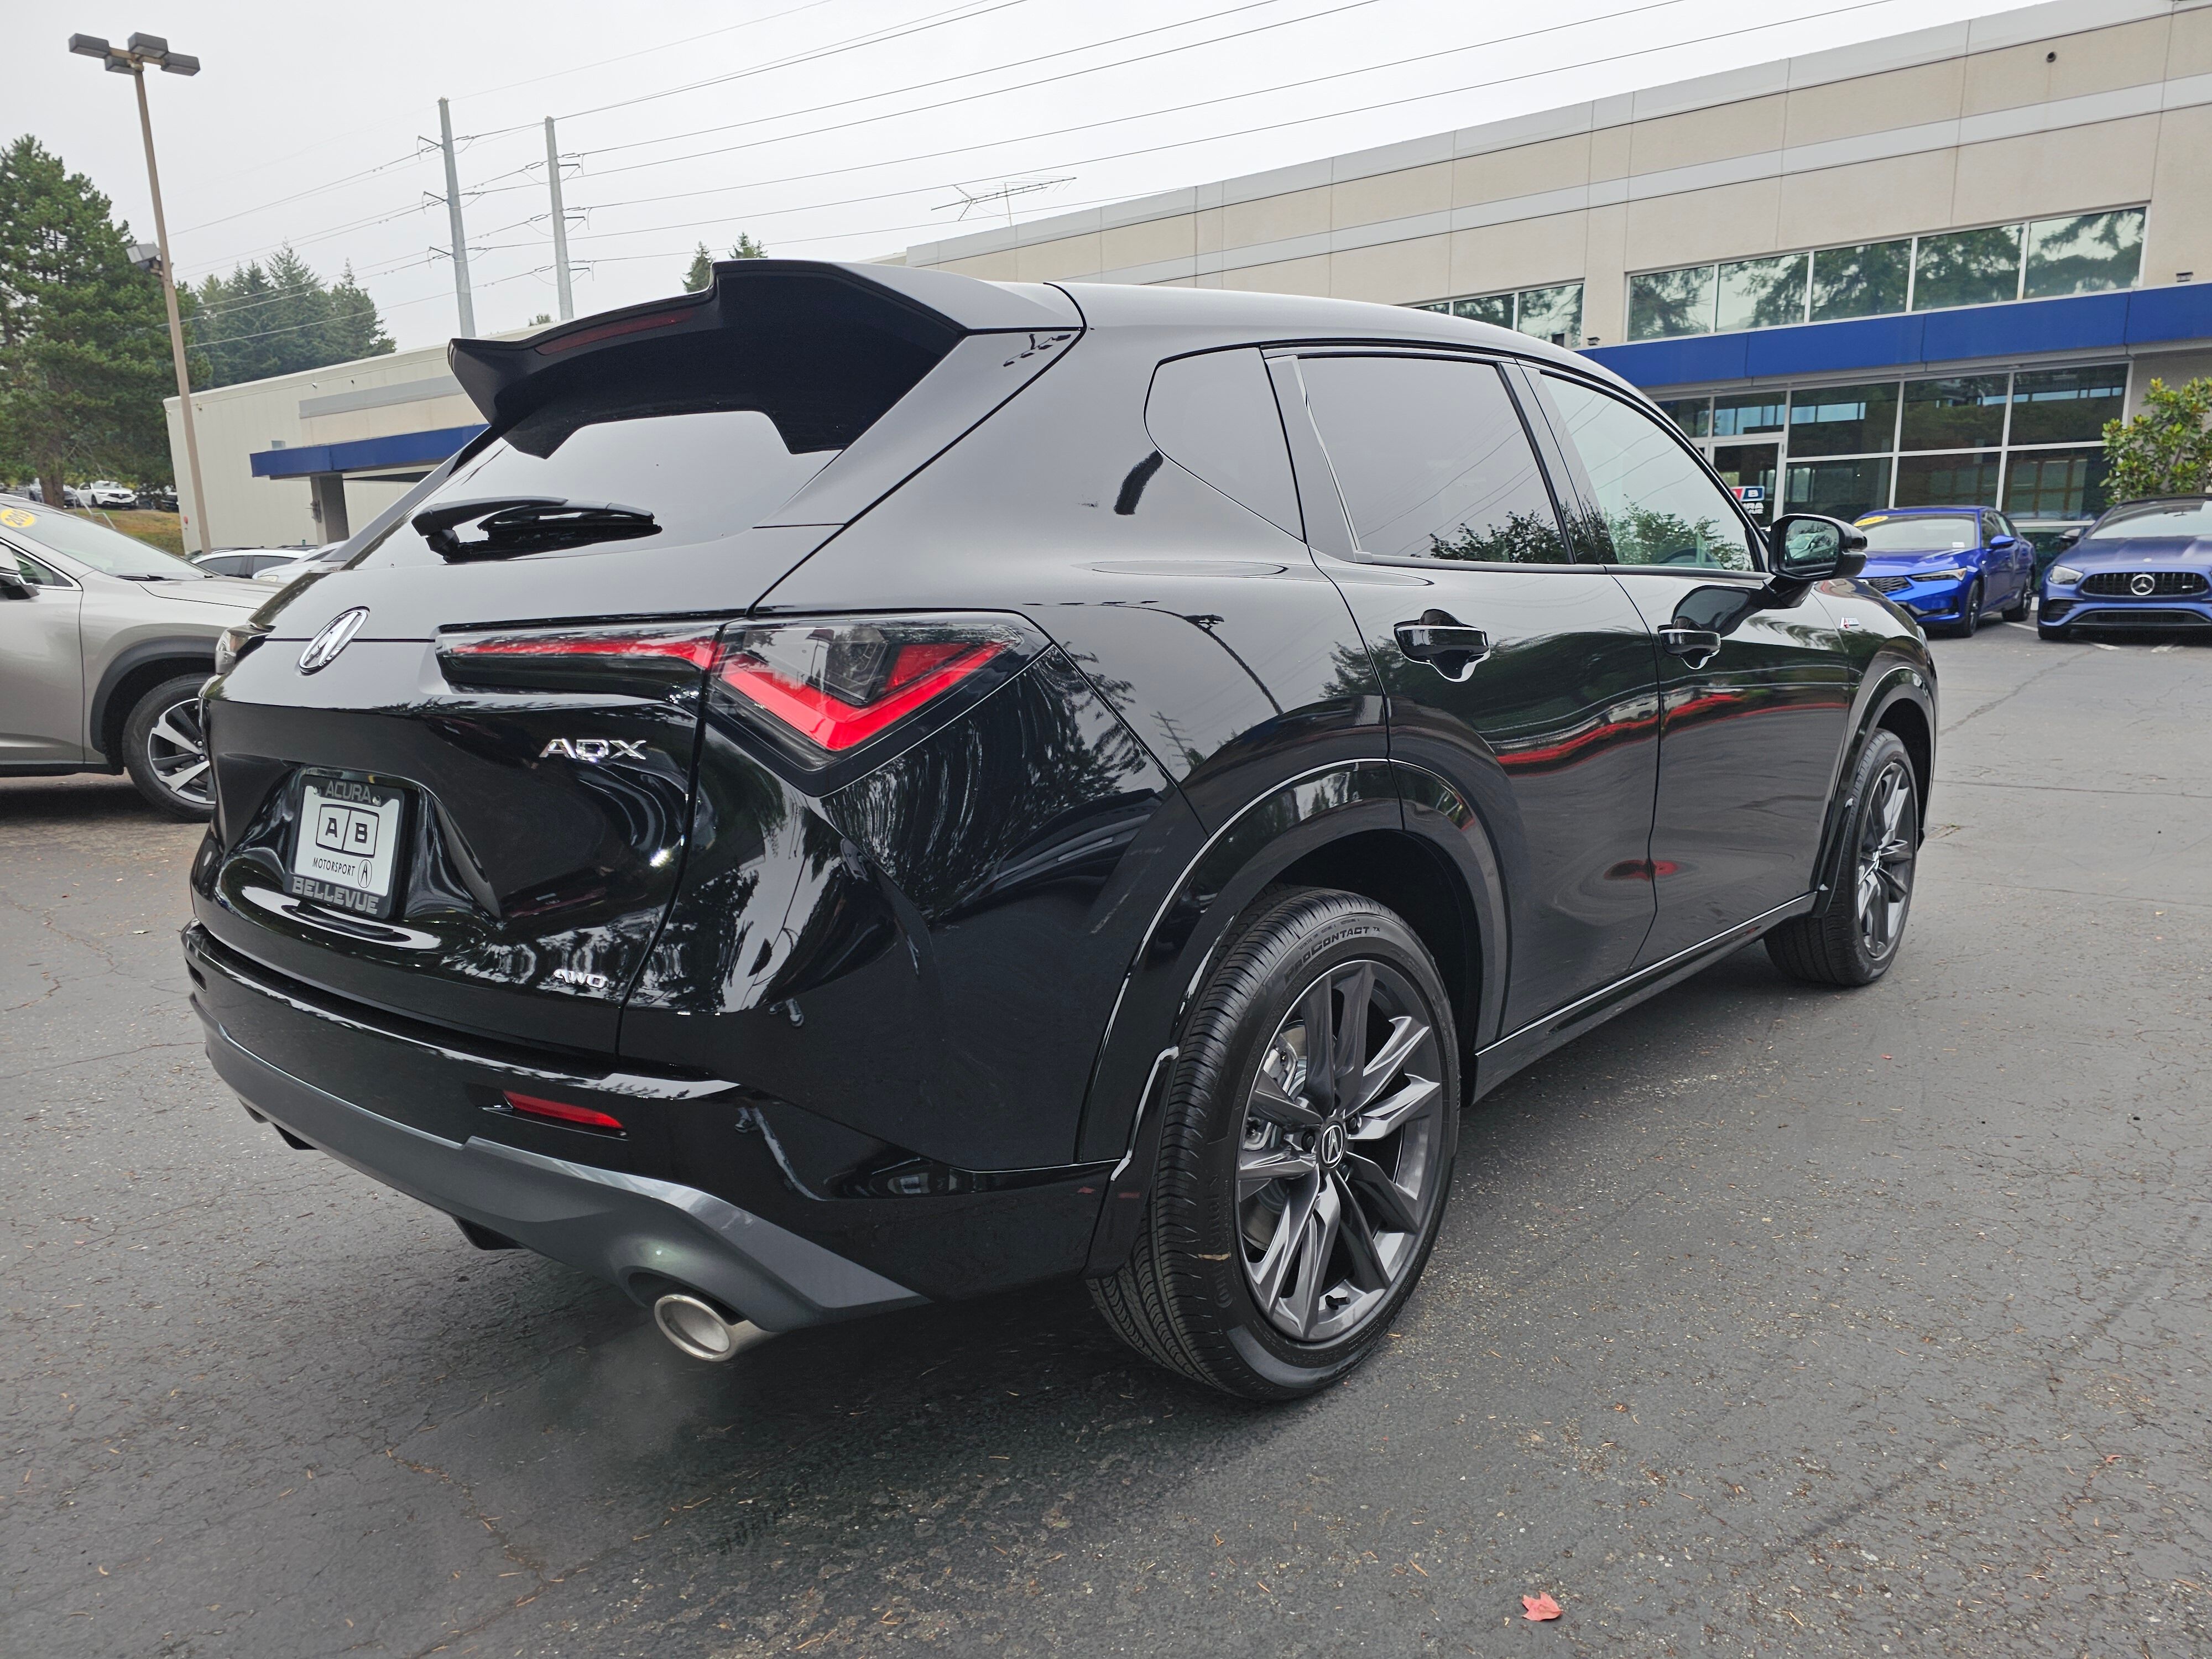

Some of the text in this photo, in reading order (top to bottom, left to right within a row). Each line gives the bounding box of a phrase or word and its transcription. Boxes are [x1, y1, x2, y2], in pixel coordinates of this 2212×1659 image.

[539, 738, 646, 762] ADX
[325, 780, 372, 803] ACURA
[312, 857, 356, 877] MOTORSPORT
[291, 877, 379, 915] BELLEVUE
[552, 969, 608, 988] AWD
